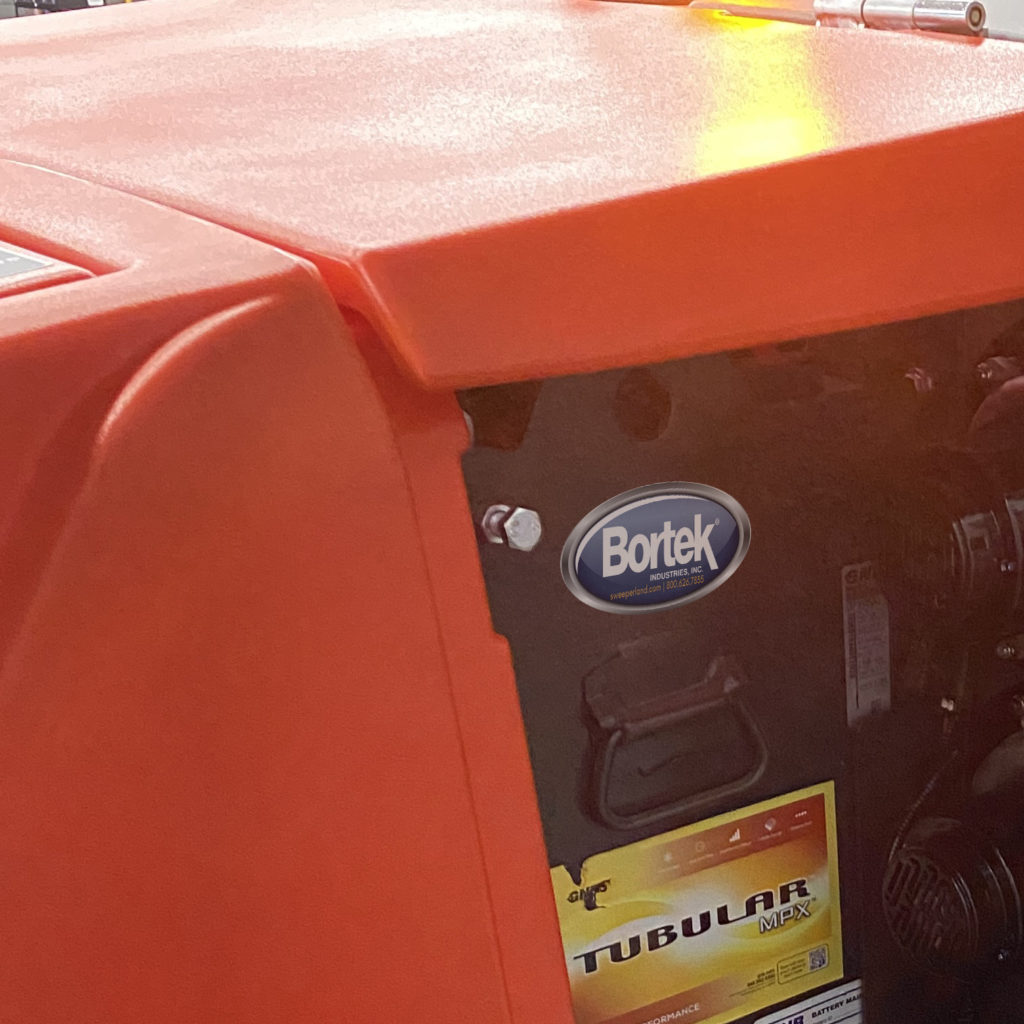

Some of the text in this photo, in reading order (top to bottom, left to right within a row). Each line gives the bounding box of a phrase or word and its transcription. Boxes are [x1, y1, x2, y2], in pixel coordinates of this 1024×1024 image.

[602, 513, 719, 578] Bortek
[573, 878, 811, 974] TUBULAR
[758, 900, 812, 934] MPX
[811, 1000, 844, 1018] BATTERY
